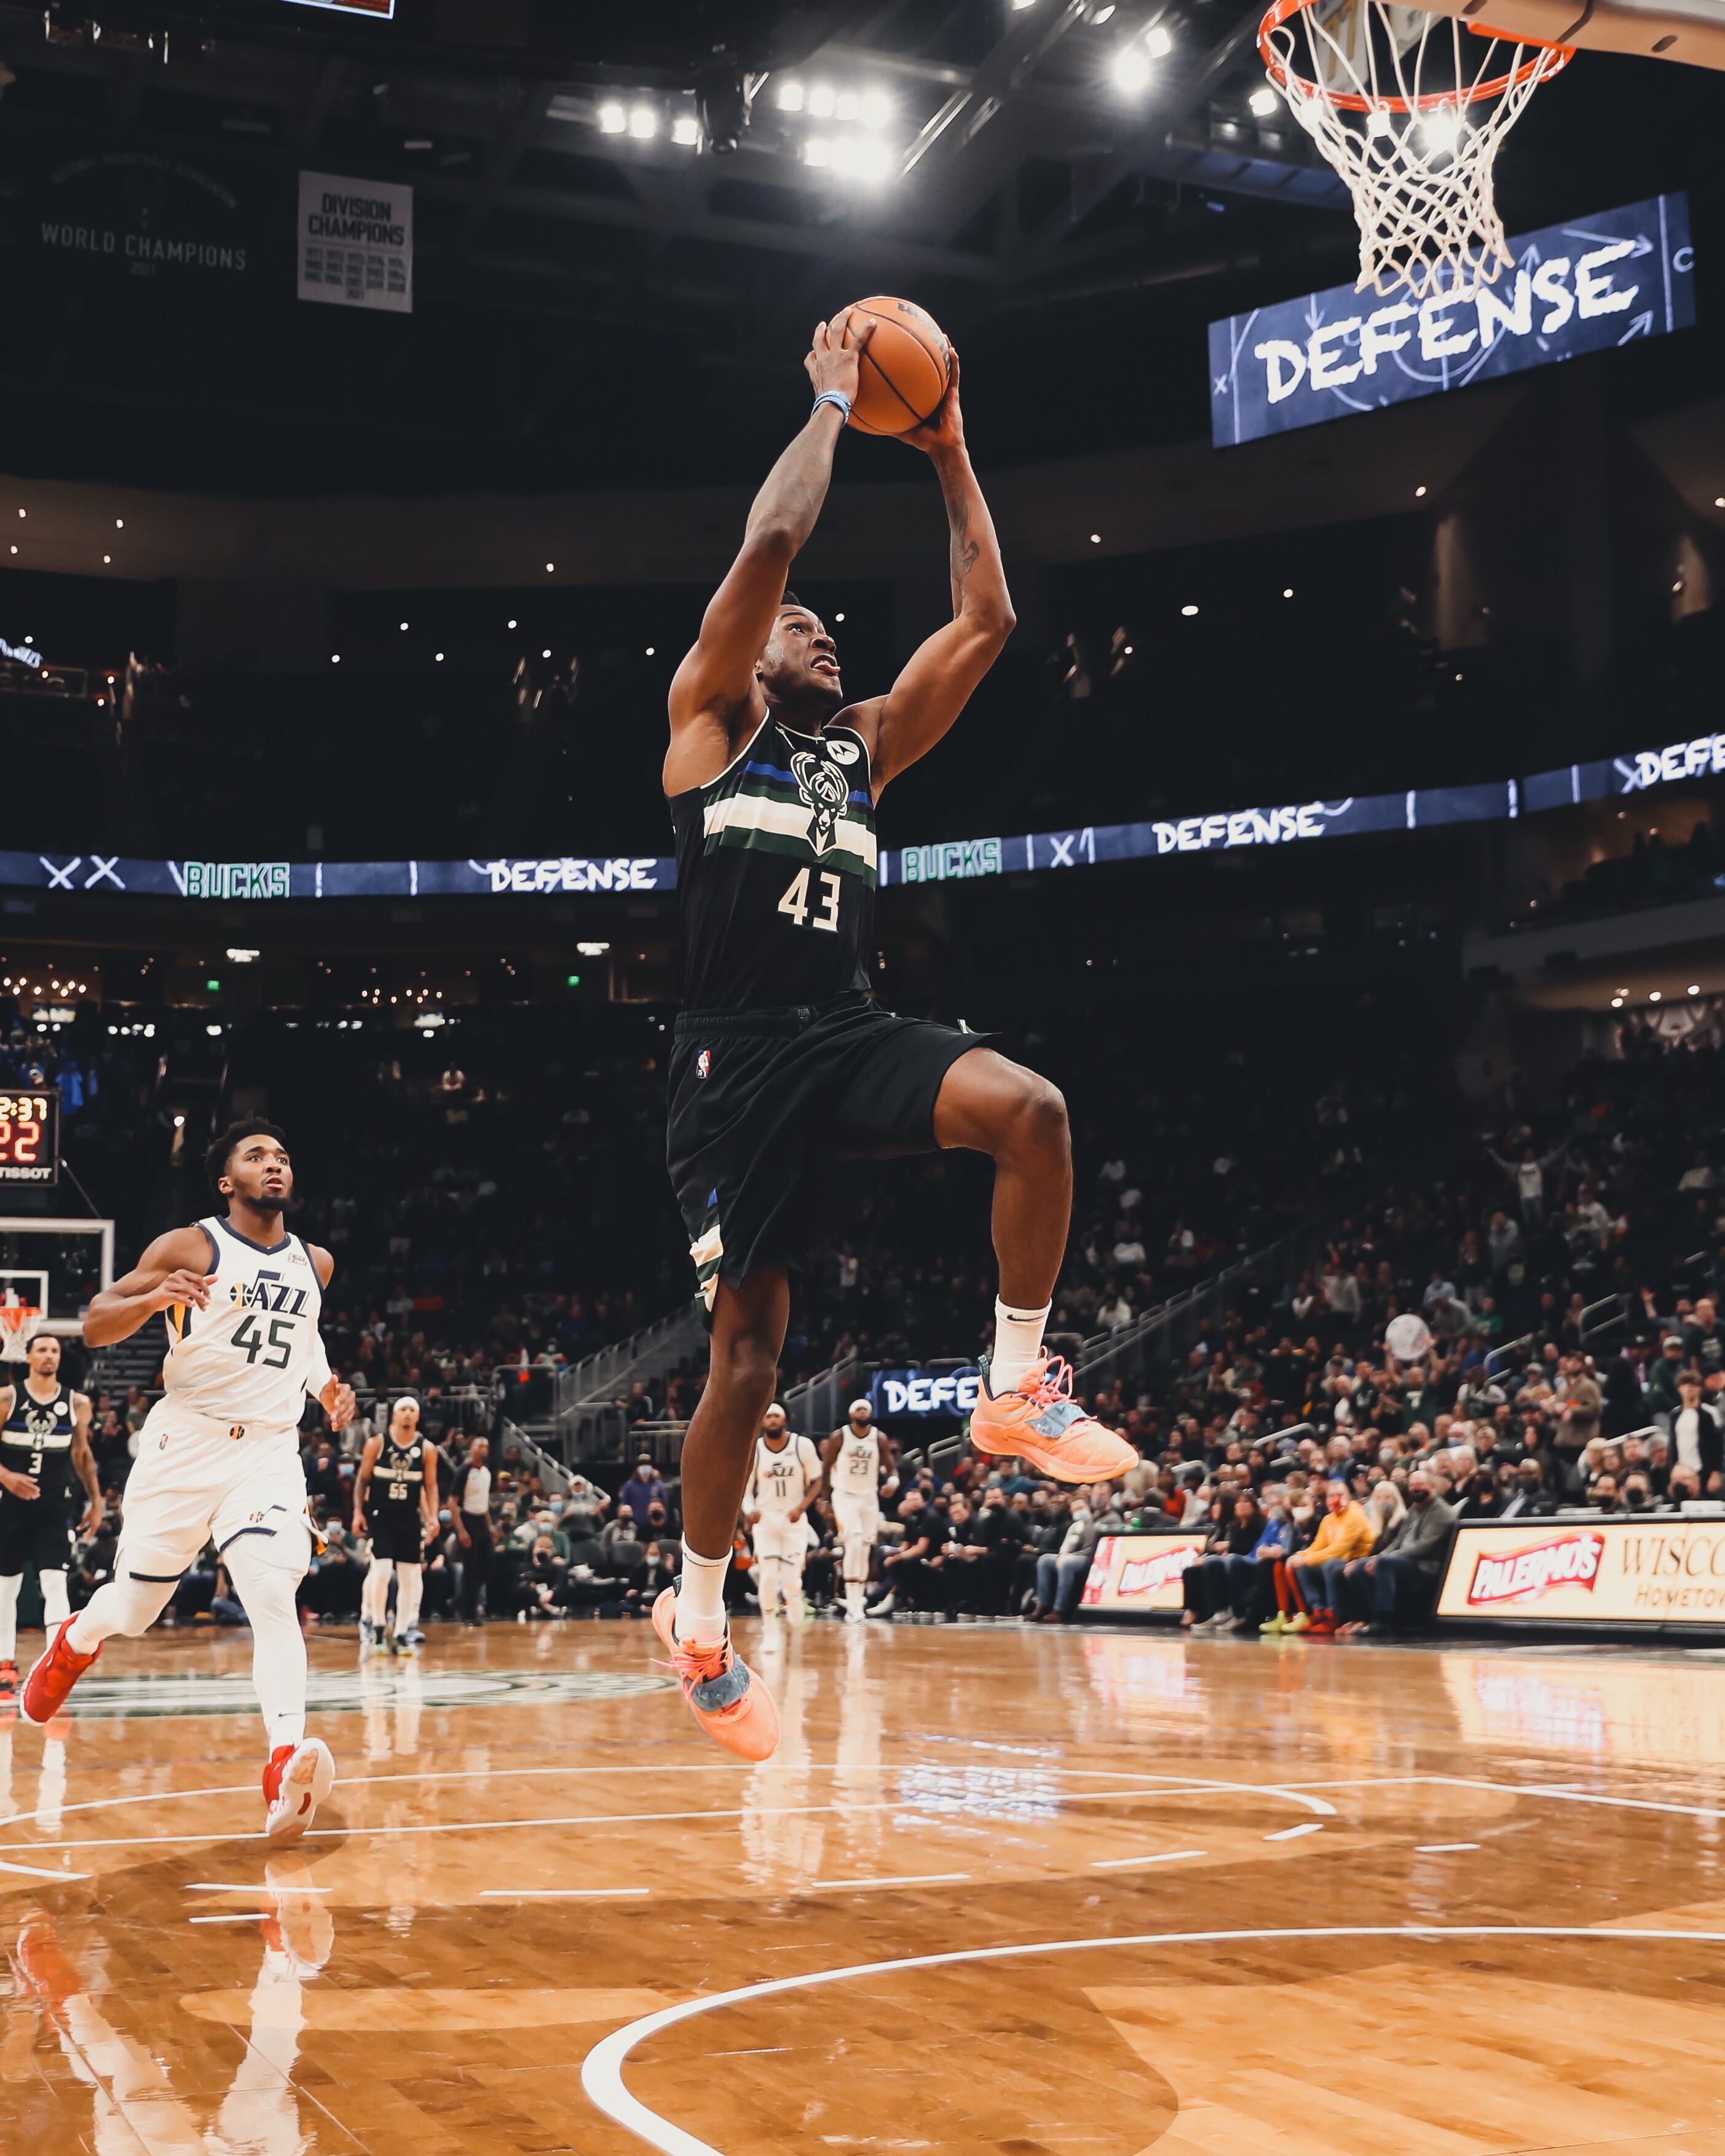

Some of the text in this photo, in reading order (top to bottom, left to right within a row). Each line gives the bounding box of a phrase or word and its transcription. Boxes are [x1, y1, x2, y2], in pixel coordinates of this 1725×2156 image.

[322, 192, 392, 222] DIVISION
[41, 221, 247, 271] WORLD CHAMPIONS
[308, 214, 405, 247] CHAMPIONS
[1254, 241, 1640, 403] DEFENSE
[1151, 801, 1325, 854] DEFENSE
[486, 857, 658, 894] DEFENSE
[901, 837, 1003, 885] BUCKS
[184, 861, 291, 899] BUCKS
[777, 867, 841, 932] 43
[231, 1315, 295, 1369] 45
[882, 1376, 981, 1413] DEFE
[28, 1452, 43, 1474] 3
[850, 1459, 868, 1474] 23
[388, 1482, 408, 1500] 55
[776, 1480, 786, 1497] 11
[1470, 1536, 1602, 1599] PALERMO'S
